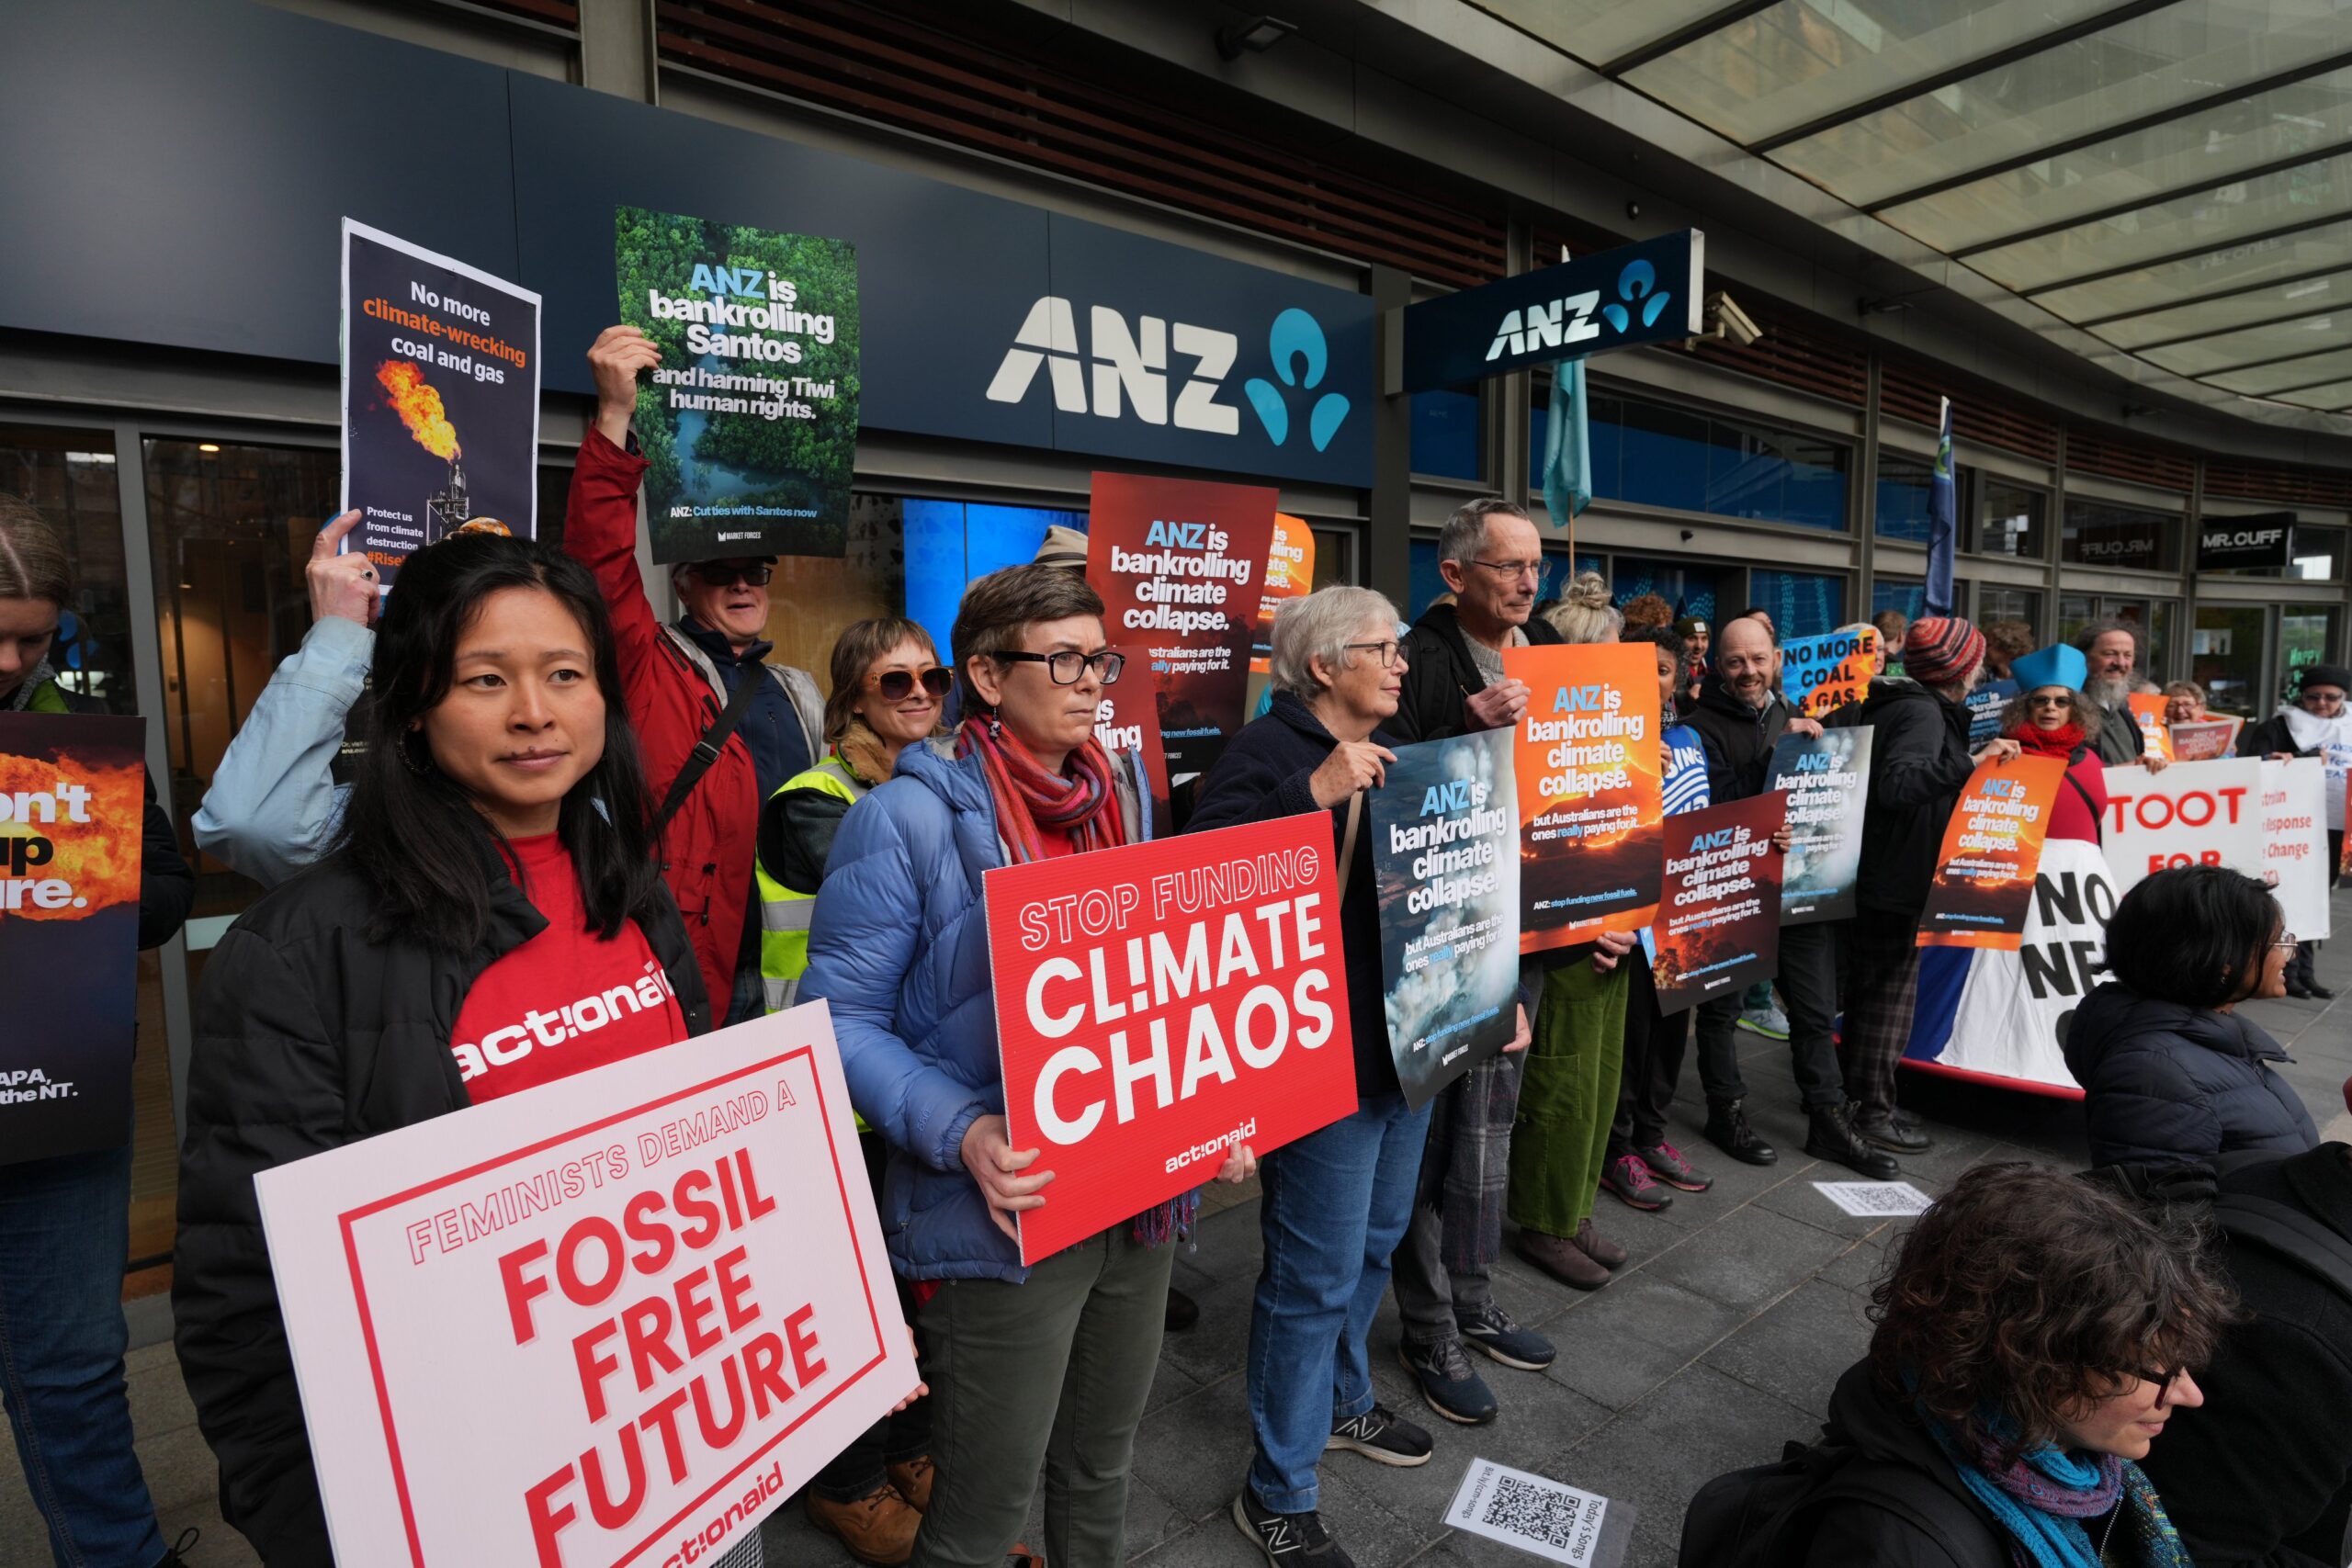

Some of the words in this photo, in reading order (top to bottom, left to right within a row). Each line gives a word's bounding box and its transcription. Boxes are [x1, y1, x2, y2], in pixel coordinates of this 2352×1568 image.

[690, 264, 765, 299] ANZ
[768, 271, 797, 301] is
[411, 281, 439, 307] No
[444, 297, 490, 326] more
[650, 289, 834, 344] bankrolling
[364, 298, 526, 367] climate-wrecking
[1486, 290, 1600, 361] ANZ
[687, 324, 801, 364] Santos
[391, 338, 433, 363] coal
[437, 348, 470, 375] and
[474, 363, 504, 384] gas
[986, 295, 1238, 435] ANZ
[652, 367, 696, 386] and
[699, 372, 789, 399] harming
[792, 378, 834, 399] Tiwi
[671, 389, 747, 412] human
[752, 397, 817, 420] rights.
[367, 506, 401, 520] Protect
[671, 506, 692, 517] ANZ:
[693, 506, 711, 516] Cut
[712, 505, 730, 515] ties
[731, 505, 754, 515] with
[755, 505, 796, 516] Santos
[794, 508, 817, 518] now
[367, 522, 390, 533] from
[390, 525, 424, 537] climate
[367, 536, 418, 550] destruction
[1145, 520, 1205, 549] ANZ
[1207, 524, 1228, 551] is
[2203, 534, 2233, 548] MR.
[2233, 529, 2282, 546] CUFF
[368, 551, 406, 566] #Rise
[1111, 547, 1251, 585] bankrolling
[1136, 577, 1227, 604] climate
[1123, 604, 1229, 636] collapse.
[1198, 649, 1215, 658] are
[1215, 647, 1231, 657] the
[1784, 646, 1812, 666] NO
[1817, 636, 1873, 660] MORE
[1172, 660, 1206, 674] paying
[1206, 659, 1221, 671] for
[1221, 659, 1229, 670] it.
[1802, 664, 1855, 688] COAL
[1553, 685, 1600, 713] ANZ
[1603, 683, 1621, 709] is
[1799, 695, 1810, 711] &
[1816, 688, 1856, 708] GAS
[1527, 712, 1644, 742] bankrolling
[1547, 740, 1624, 769] climate
[1795, 753, 1830, 771] ANZ
[1830, 750, 1843, 769] is
[1539, 769, 1632, 798] collapse.
[1775, 771, 1858, 790] bankrolling
[1980, 778, 2012, 796] ANZ
[2010, 781, 2026, 798] is
[1419, 779, 1469, 817] ANZ
[1470, 776, 1487, 807] is
[1786, 788, 1841, 807] climate
[1962, 795, 2040, 822] bankrolling
[2108, 786, 2247, 833] TOOT
[1390, 805, 1507, 854] bankrolling
[1532, 829, 1556, 840] ones
[1557, 825, 1583, 838] really
[1584, 820, 1616, 837] paying
[1616, 818, 1630, 829] for
[1630, 818, 1639, 829] it.
[1533, 816, 1551, 827] but
[1552, 808, 1606, 825] Australians
[1606, 807, 1622, 818] are
[1623, 805, 1638, 816] the
[1968, 814, 2018, 833] climate
[1690, 829, 1733, 852] ANZ
[1735, 826, 1751, 843] is
[1959, 831, 2018, 853] collapse.
[2267, 842, 2309, 861] Change
[1412, 843, 1493, 880] climate
[1666, 839, 1770, 874] bankrolling
[1681, 860, 1749, 887] climate
[0, 878, 88, 909] re.
[1020, 883, 1139, 952] STOP
[1152, 845, 1318, 920] FUNDING
[1408, 873, 1499, 915] collapse.
[1533, 900, 1551, 910] ANZ:
[1566, 896, 1590, 904] funding
[1674, 876, 1756, 907] collapse.
[2035, 872, 2118, 930] NO
[1668, 926, 1689, 936] ones
[1712, 912, 1740, 927] paying
[1740, 908, 1753, 918] for
[1669, 917, 1684, 927] but
[1684, 907, 1732, 922] Australians
[1732, 902, 1746, 911] are
[1746, 898, 1760, 908] the
[1405, 942, 1422, 955] but
[1423, 924, 1475, 950] Australians
[1476, 919, 1491, 931] are
[1491, 913, 1504, 927] the
[1406, 955, 1429, 973] ones
[1429, 944, 1453, 963] really
[1453, 936, 1486, 958] paying
[1486, 931, 1498, 942] for
[2020, 941, 2108, 998] NE
[1413, 1038, 1426, 1053] ANZ:
[1425, 1033, 1437, 1044] stop
[1437, 1023, 1458, 1038] funding
[1034, 968, 1334, 1145] CHAOS
[40, 1082, 78, 1100] NT.
[406, 1145, 629, 1265] FEMINISTS
[637, 1089, 769, 1168] DEMAND
[775, 1080, 797, 1112] A
[497, 1147, 776, 1346] FOSSIL
[571, 1246, 762, 1425] FREE
[524, 1303, 828, 1568] FUTURE
[1582, 1499, 1602, 1532] Today's
[1572, 1533, 1592, 1561] Songs
